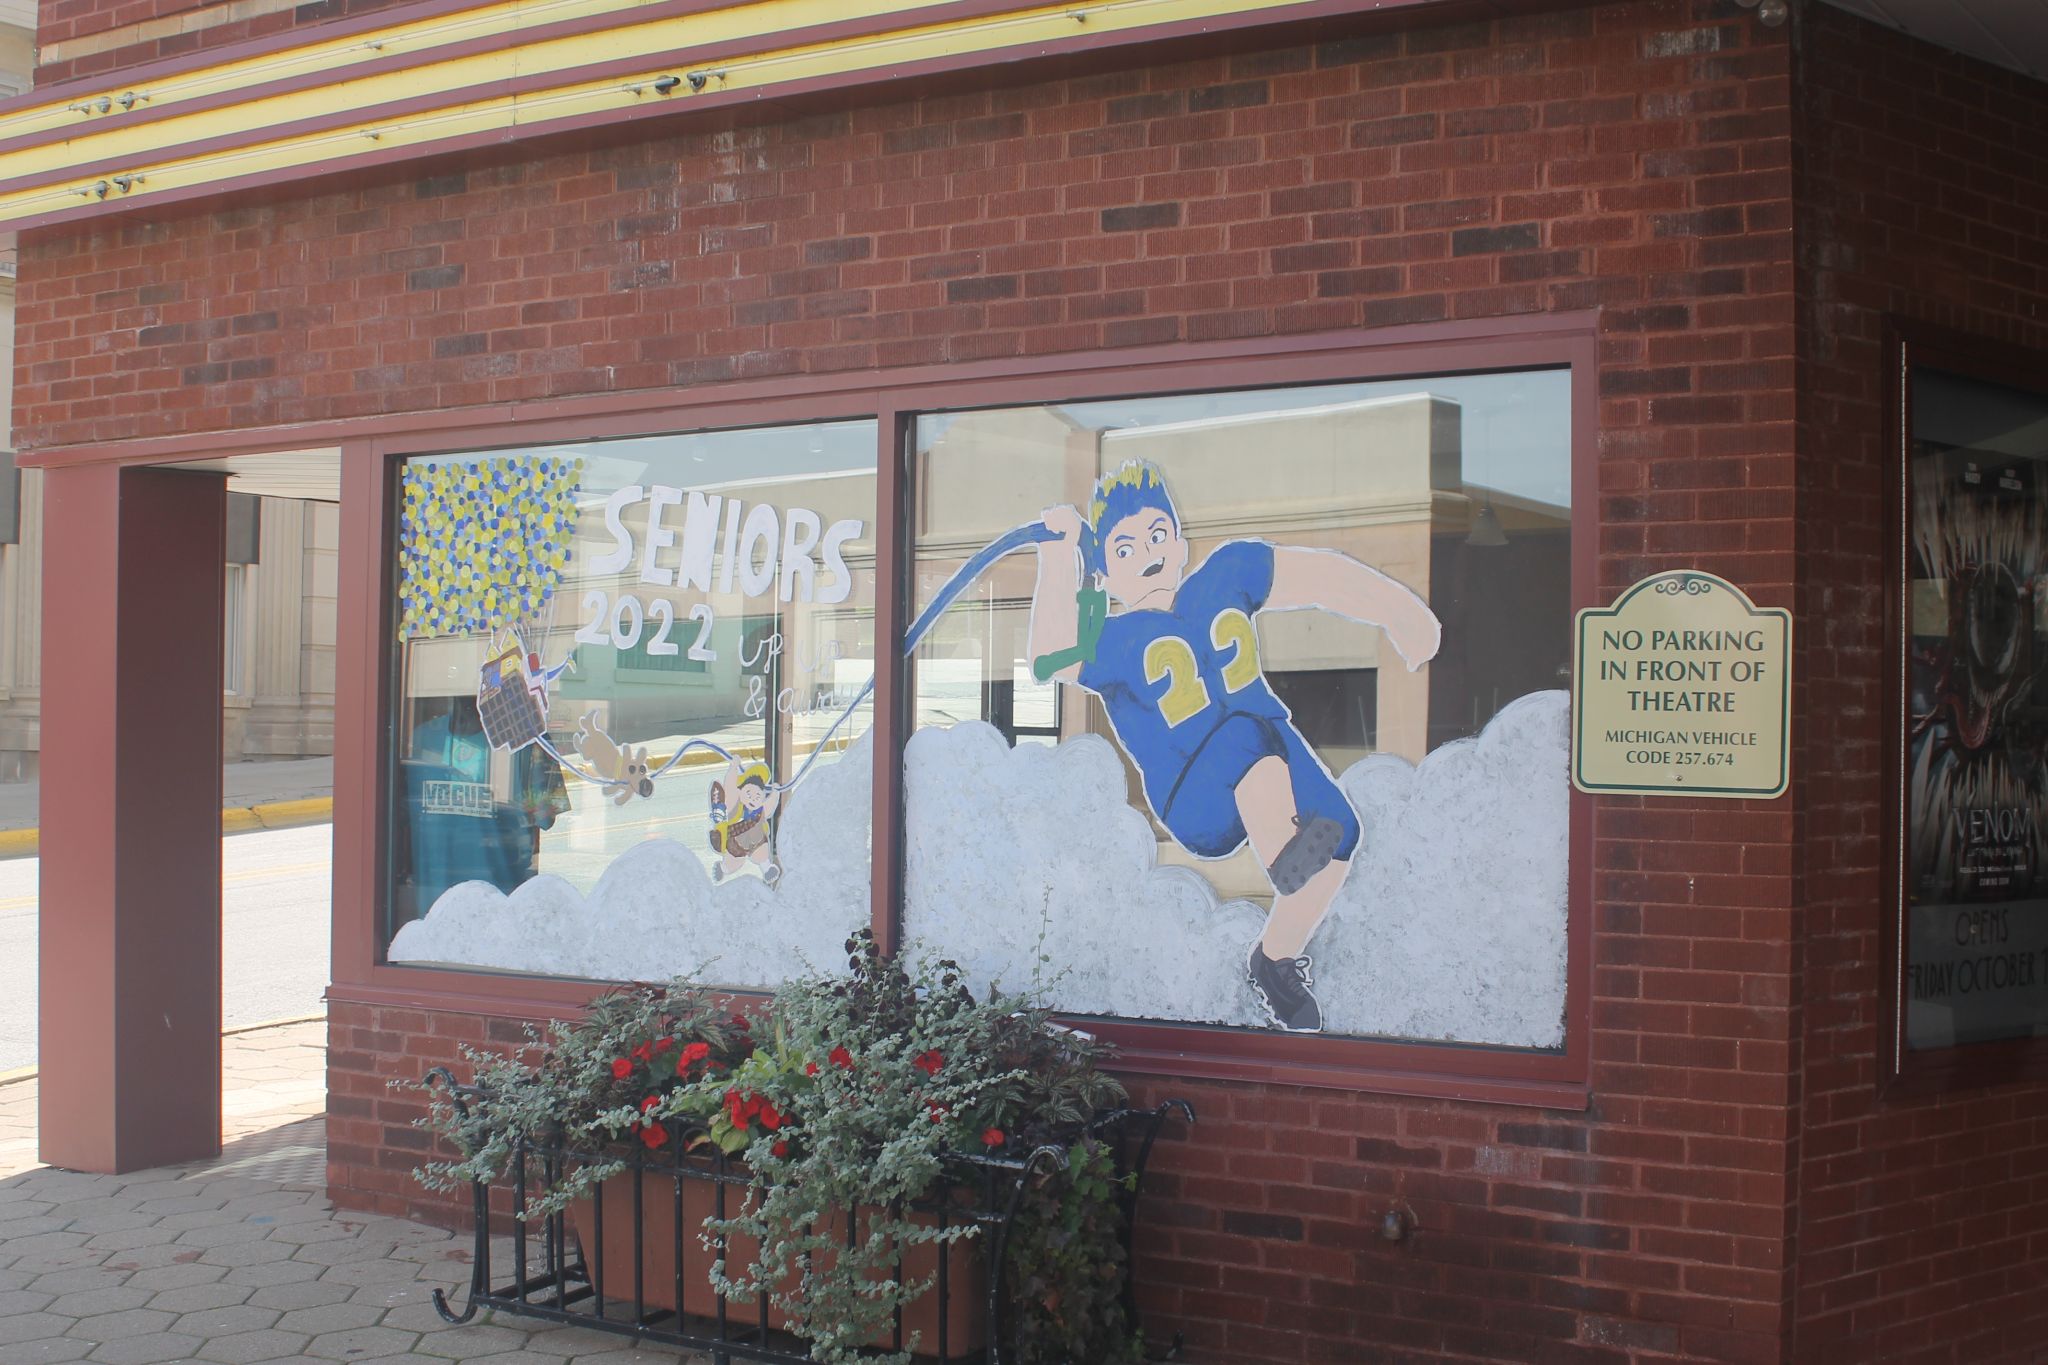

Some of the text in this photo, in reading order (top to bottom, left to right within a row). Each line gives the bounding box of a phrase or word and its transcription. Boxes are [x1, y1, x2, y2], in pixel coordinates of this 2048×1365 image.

[588, 485, 864, 604] SENIORS
[574, 590, 717, 662] 2022
[1602, 630, 1764, 651] NO PARKING
[1143, 608, 1261, 729] 22
[1600, 660, 1765, 682] IN FRONT OF
[743, 675, 767, 718] &
[1627, 691, 1735, 712] THEATRE
[1605, 730, 1757, 746] MICHIGAN VEHICLE
[1626, 751, 1734, 765] CODE 257.674
[1952, 807, 2031, 848] VENOM
[1955, 908, 2009, 946] OPENS
[1907, 961, 1954, 1000] FRIDAY
[1958, 951, 2035, 993] OCTOBER
